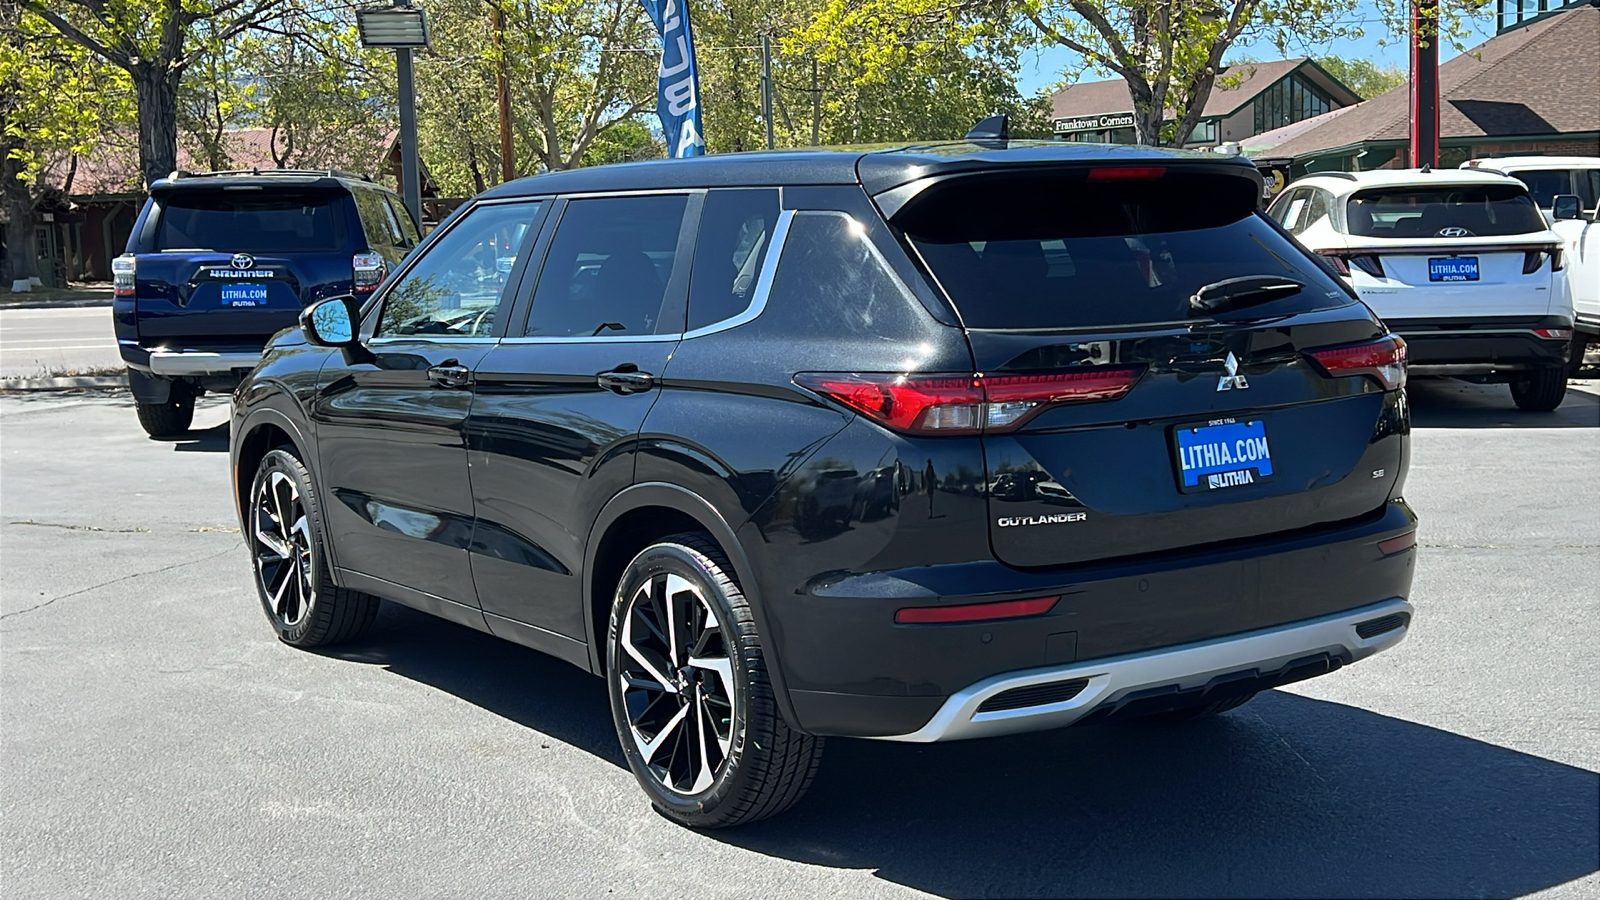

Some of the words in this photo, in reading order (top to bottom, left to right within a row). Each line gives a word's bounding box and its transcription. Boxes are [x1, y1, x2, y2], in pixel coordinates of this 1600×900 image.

[1055, 119, 1098, 131] Franktown
[1100, 116, 1133, 127] Corners
[1431, 264, 1478, 274] LITHIA.COM
[221, 290, 267, 299] LITHIA.COM
[1179, 436, 1270, 471] LITHIA.COM
[1218, 469, 1255, 488] LITHIA
[1372, 468, 1385, 479] SE
[997, 511, 1087, 527] OUTLANDER
